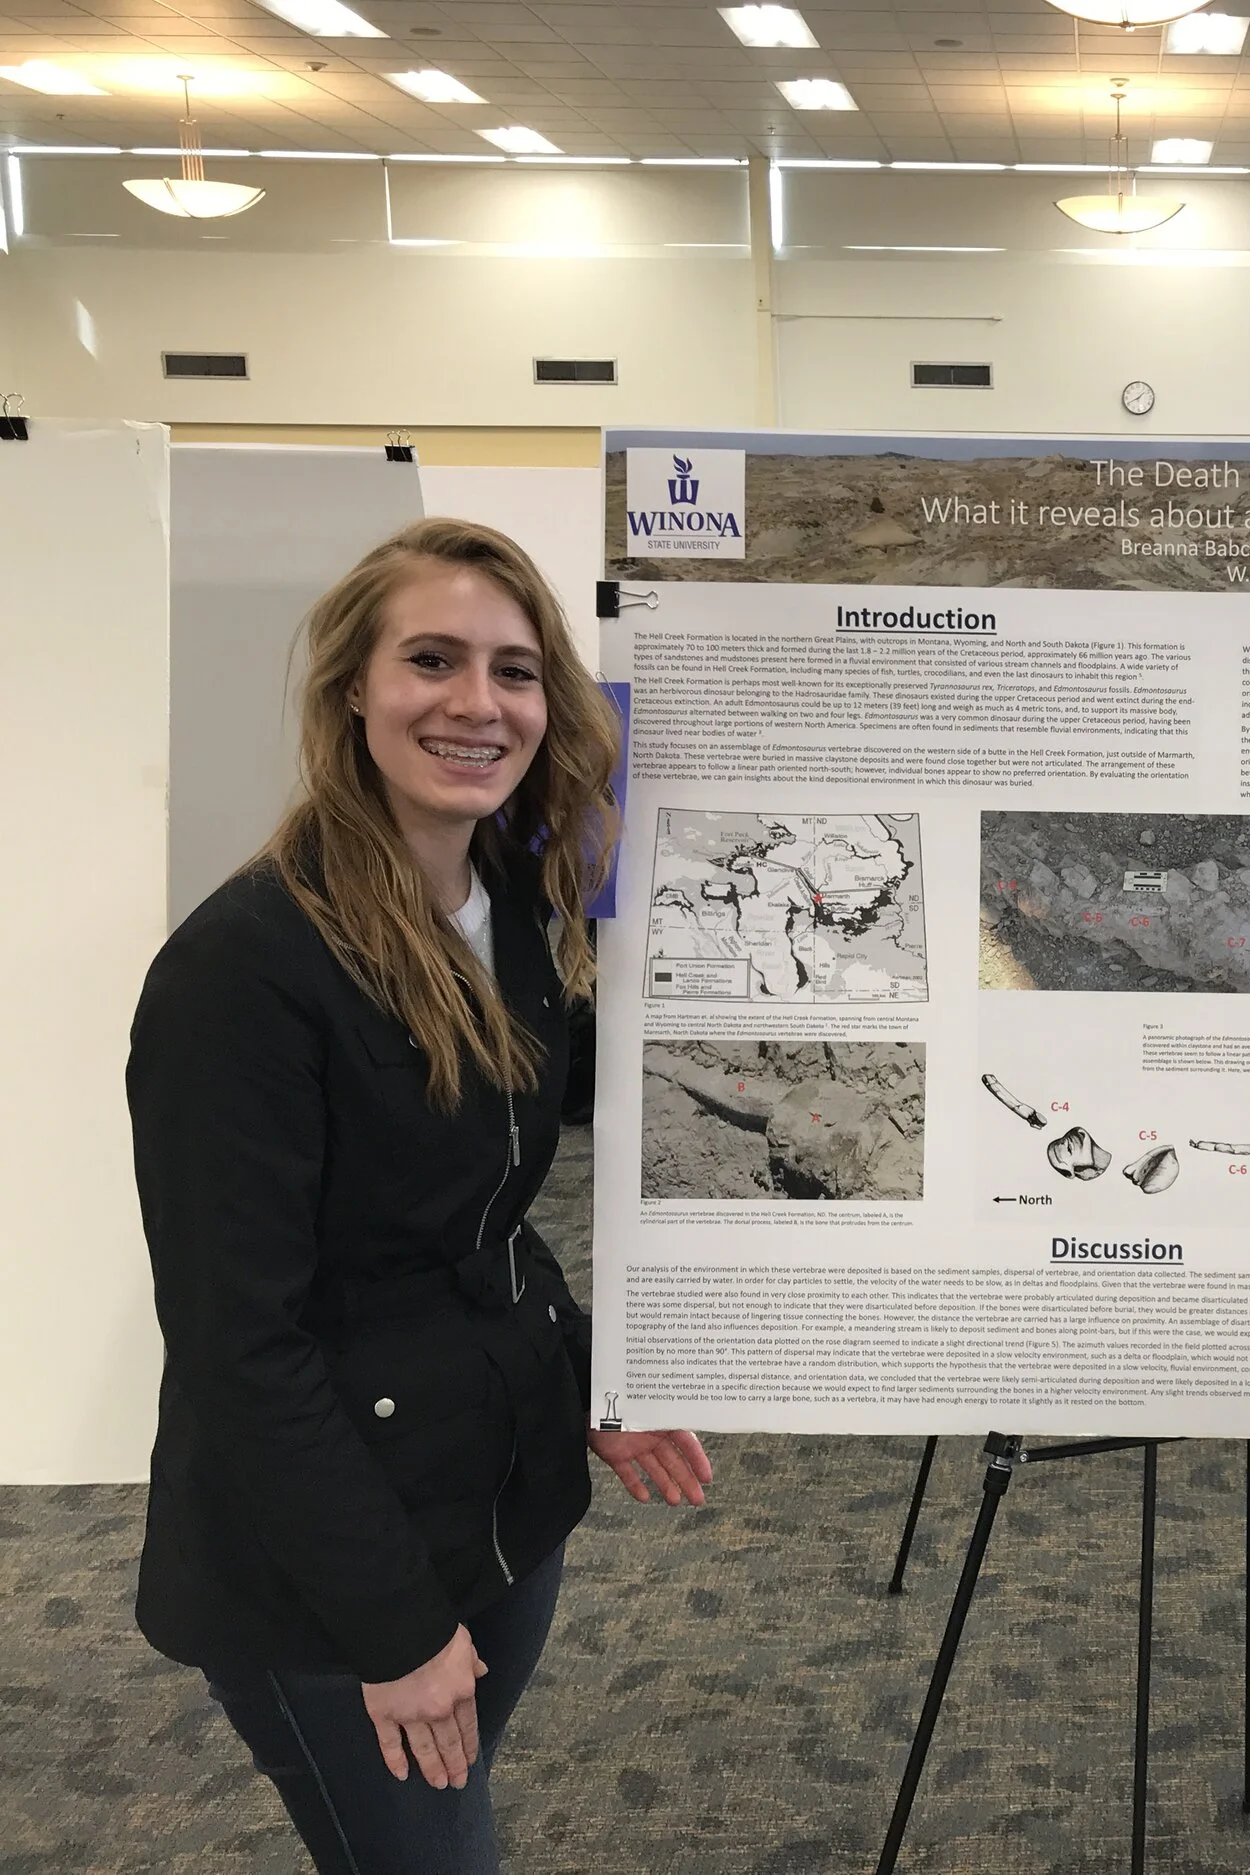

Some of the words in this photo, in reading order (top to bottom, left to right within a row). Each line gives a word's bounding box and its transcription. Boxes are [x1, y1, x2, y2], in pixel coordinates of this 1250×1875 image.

[1090, 458, 1144, 488] The
[1155, 460, 1239, 488] Death
[921, 496, 1000, 524] What
[1010, 498, 1028, 525] it
[1039, 500, 1140, 528] reveals
[1150, 501, 1235, 529] about
[627, 511, 742, 537] WINONA
[648, 540, 672, 550] STATE
[674, 540, 720, 550] UNIVERSITY
[1121, 539, 1199, 556] Breanna
[837, 606, 996, 630] Introduction
[633, 631, 648, 639] The
[648, 631, 663, 639] Hell
[664, 631, 685, 640] Creek
[686, 632, 723, 640] Formation
[724, 633, 730, 641] is
[731, 633, 758, 641] located
[759, 633, 766, 642] in
[767, 634, 779, 642] the
[781, 634, 813, 642] northern
[813, 635, 834, 643] Great
[835, 635, 858, 645] Plains,
[859, 635, 875, 644] with
[876, 636, 908, 646] outcrops
[909, 636, 916, 645] in
[917, 637, 952, 646] Montana,
[953, 638, 988, 648] Wyoming,
[990, 638, 1004, 646] and
[1005, 638, 1026, 647] North
[1027, 639, 1041, 647] and
[1042, 639, 1063, 647] South
[1064, 640, 1089, 648] Dakota
[1090, 640, 1115, 650] (Figure
[1116, 641, 1127, 651] 1).
[1127, 641, 1142, 649] This
[1143, 641, 1178, 650] formation
[1179, 642, 1185, 650] is
[1131, 917, 1150, 927] C-6
[1227, 938, 1247, 948] C-7
[738, 1082, 745, 1092] B
[1050, 1102, 1070, 1112] C-4
[812, 1112, 820, 1122] A
[1139, 1130, 1157, 1140] C-5
[1228, 1165, 1247, 1175] C-6
[1019, 1195, 1052, 1205] North
[1052, 1237, 1183, 1260] Discussion
[626, 1264, 639, 1272] Our
[641, 1264, 669, 1274] analysis
[670, 1264, 678, 1272] of
[679, 1264, 691, 1272] the
[693, 1264, 738, 1272] environment
[740, 1265, 747, 1273] in
[748, 1265, 769, 1273] which
[771, 1265, 790, 1273] these
[792, 1265, 826, 1273] vertebrae
[847, 1265, 882, 1275] deposited
[883, 1266, 888, 1274] is
[890, 1266, 911, 1274] based
[924, 1266, 935, 1274] the
[937, 1266, 969, 1274] sediment
[971, 1267, 1001, 1277] samples,
[1003, 1267, 1034, 1277] dispersal
[1036, 1267, 1043, 1275] of
[1045, 1268, 1080, 1277] vertebrae,
[1082, 1268, 1095, 1276] and
[1097, 1268, 1135, 1276] orientation
[1137, 1269, 1152, 1277] data
[1154, 1269, 1187, 1277] collected.
